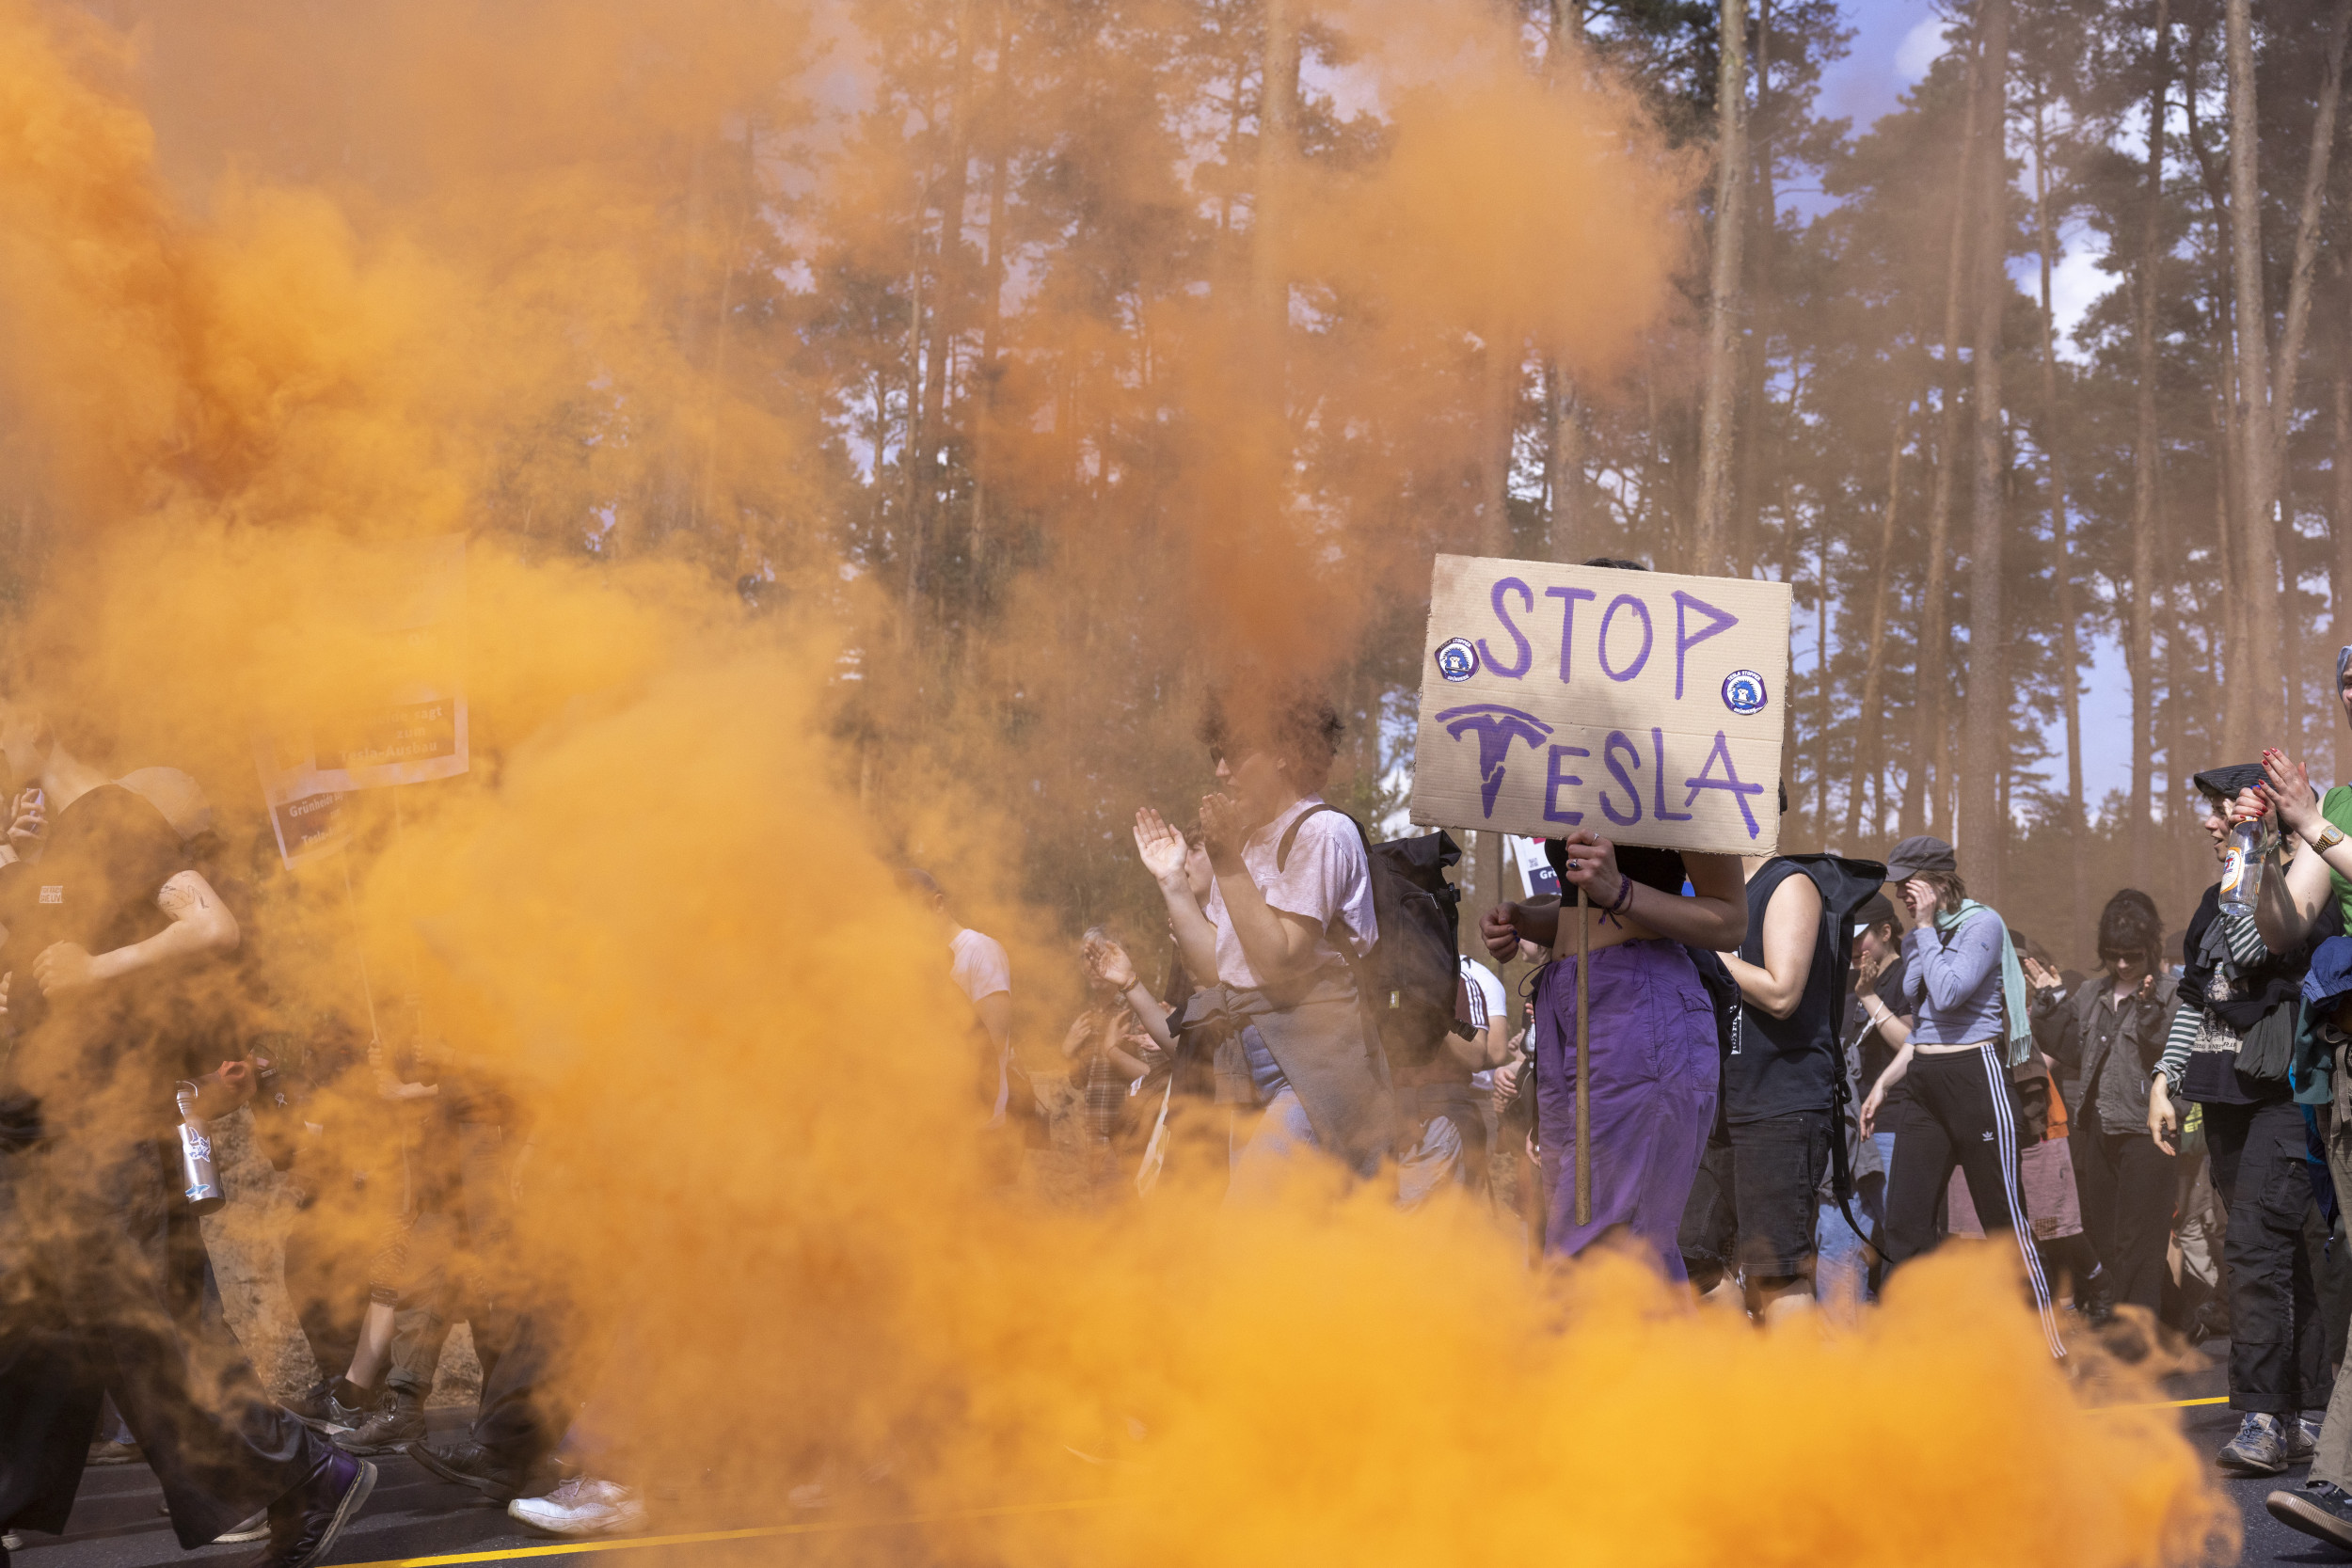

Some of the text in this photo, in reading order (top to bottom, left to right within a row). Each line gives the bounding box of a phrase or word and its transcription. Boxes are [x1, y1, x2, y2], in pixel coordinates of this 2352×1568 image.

[1475, 577, 1740, 700] STOP
[1727, 671, 1761, 681] TESLA STOPPEN
[413, 706, 442, 721] sagt
[396, 726, 426, 739] zum
[339, 741, 437, 761] Tesla-Ausbau
[1435, 704, 1764, 839] TESLA
[289, 793, 333, 817] Grünheide
